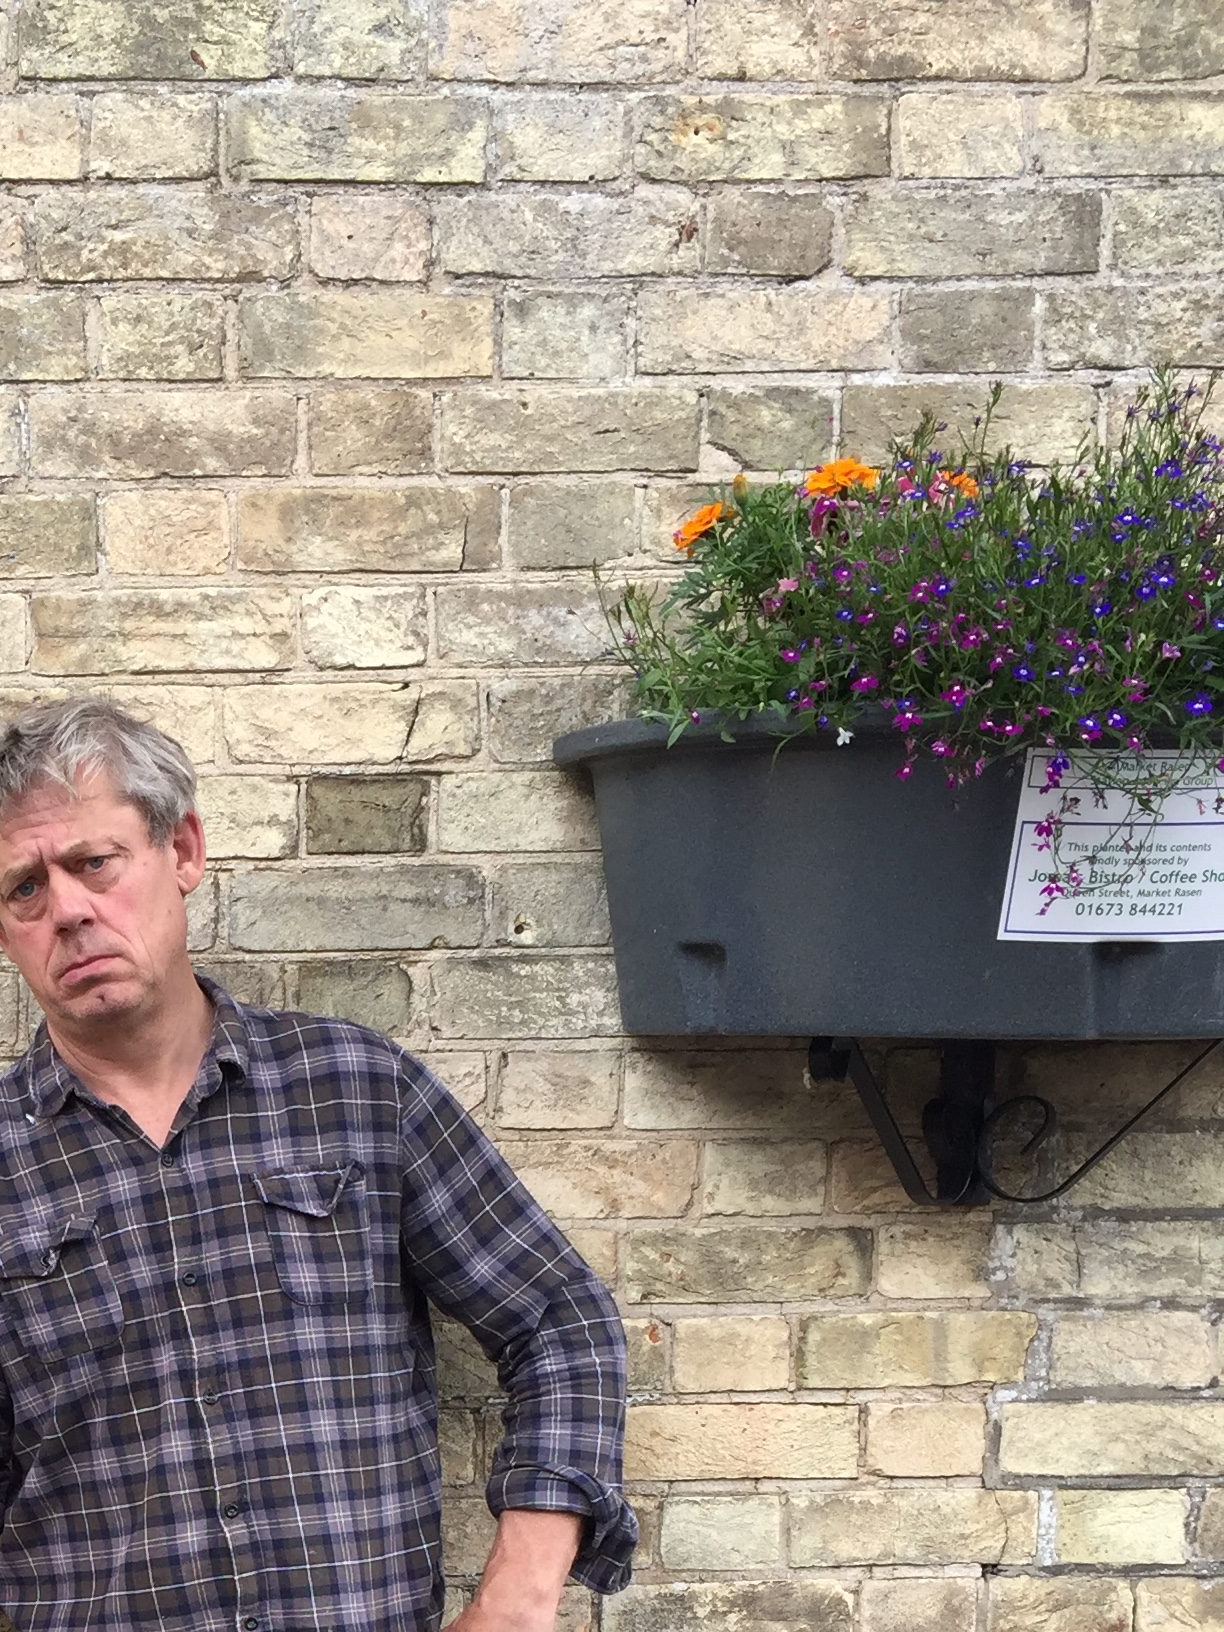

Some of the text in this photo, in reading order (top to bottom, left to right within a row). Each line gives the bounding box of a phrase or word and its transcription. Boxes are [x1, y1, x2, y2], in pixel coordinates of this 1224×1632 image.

[1182, 777, 1213, 788] Group
[1067, 842, 1212, 854] This plante and its contents
[1123, 856, 1175, 866] sponsored
[1177, 856, 1189, 867] by
[1089, 870, 1133, 884] Bistro
[1150, 870, 1197, 884] Coffee
[1098, 888, 1133, 899] Street,
[1137, 888, 1171, 898] Market
[1175, 888, 1202, 897] Rasen
[1075, 903, 1183, 916] 01673 844221
